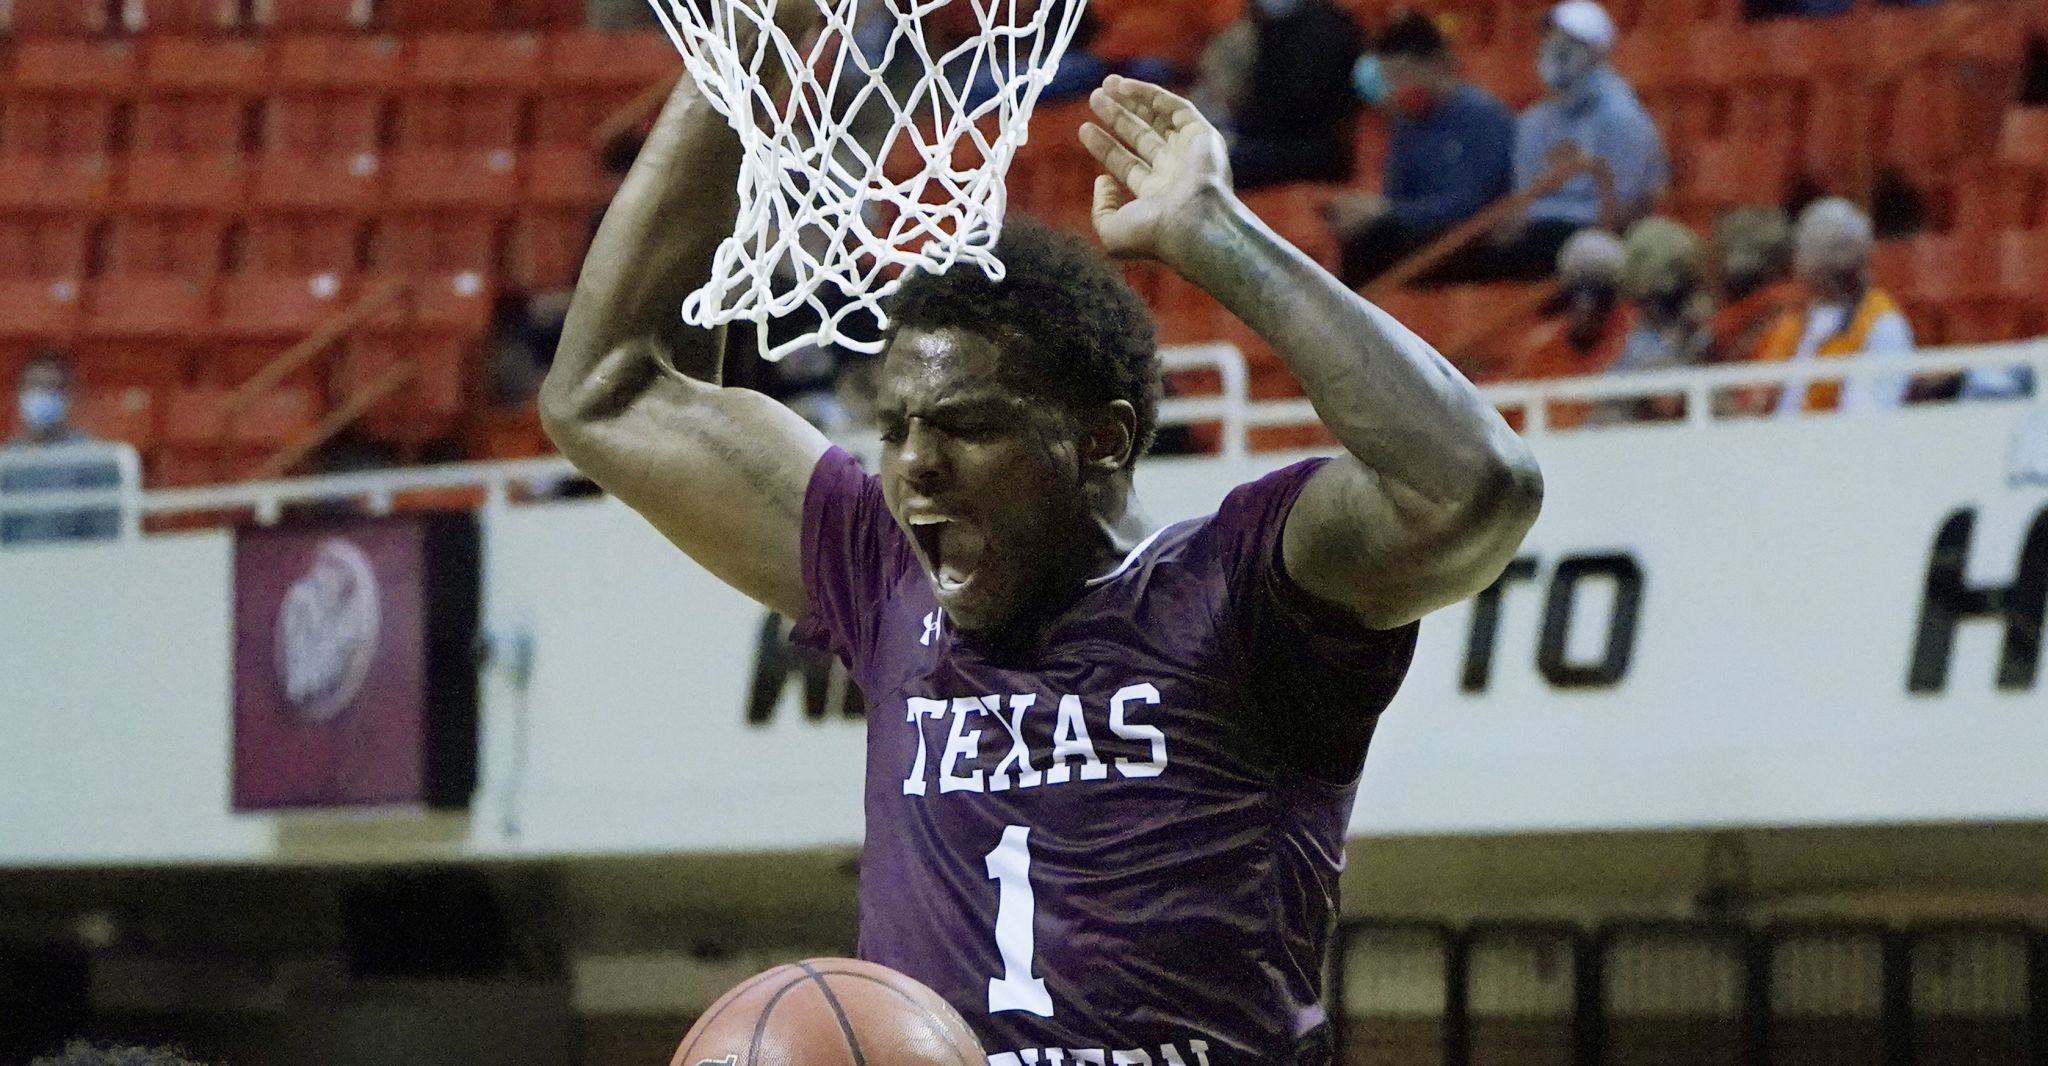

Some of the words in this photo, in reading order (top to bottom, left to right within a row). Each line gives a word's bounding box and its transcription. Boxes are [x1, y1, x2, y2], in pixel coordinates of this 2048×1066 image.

[1460, 554, 1644, 691] TO
[902, 682, 1168, 797] TEXAS
[984, 824, 1055, 1018] 1
